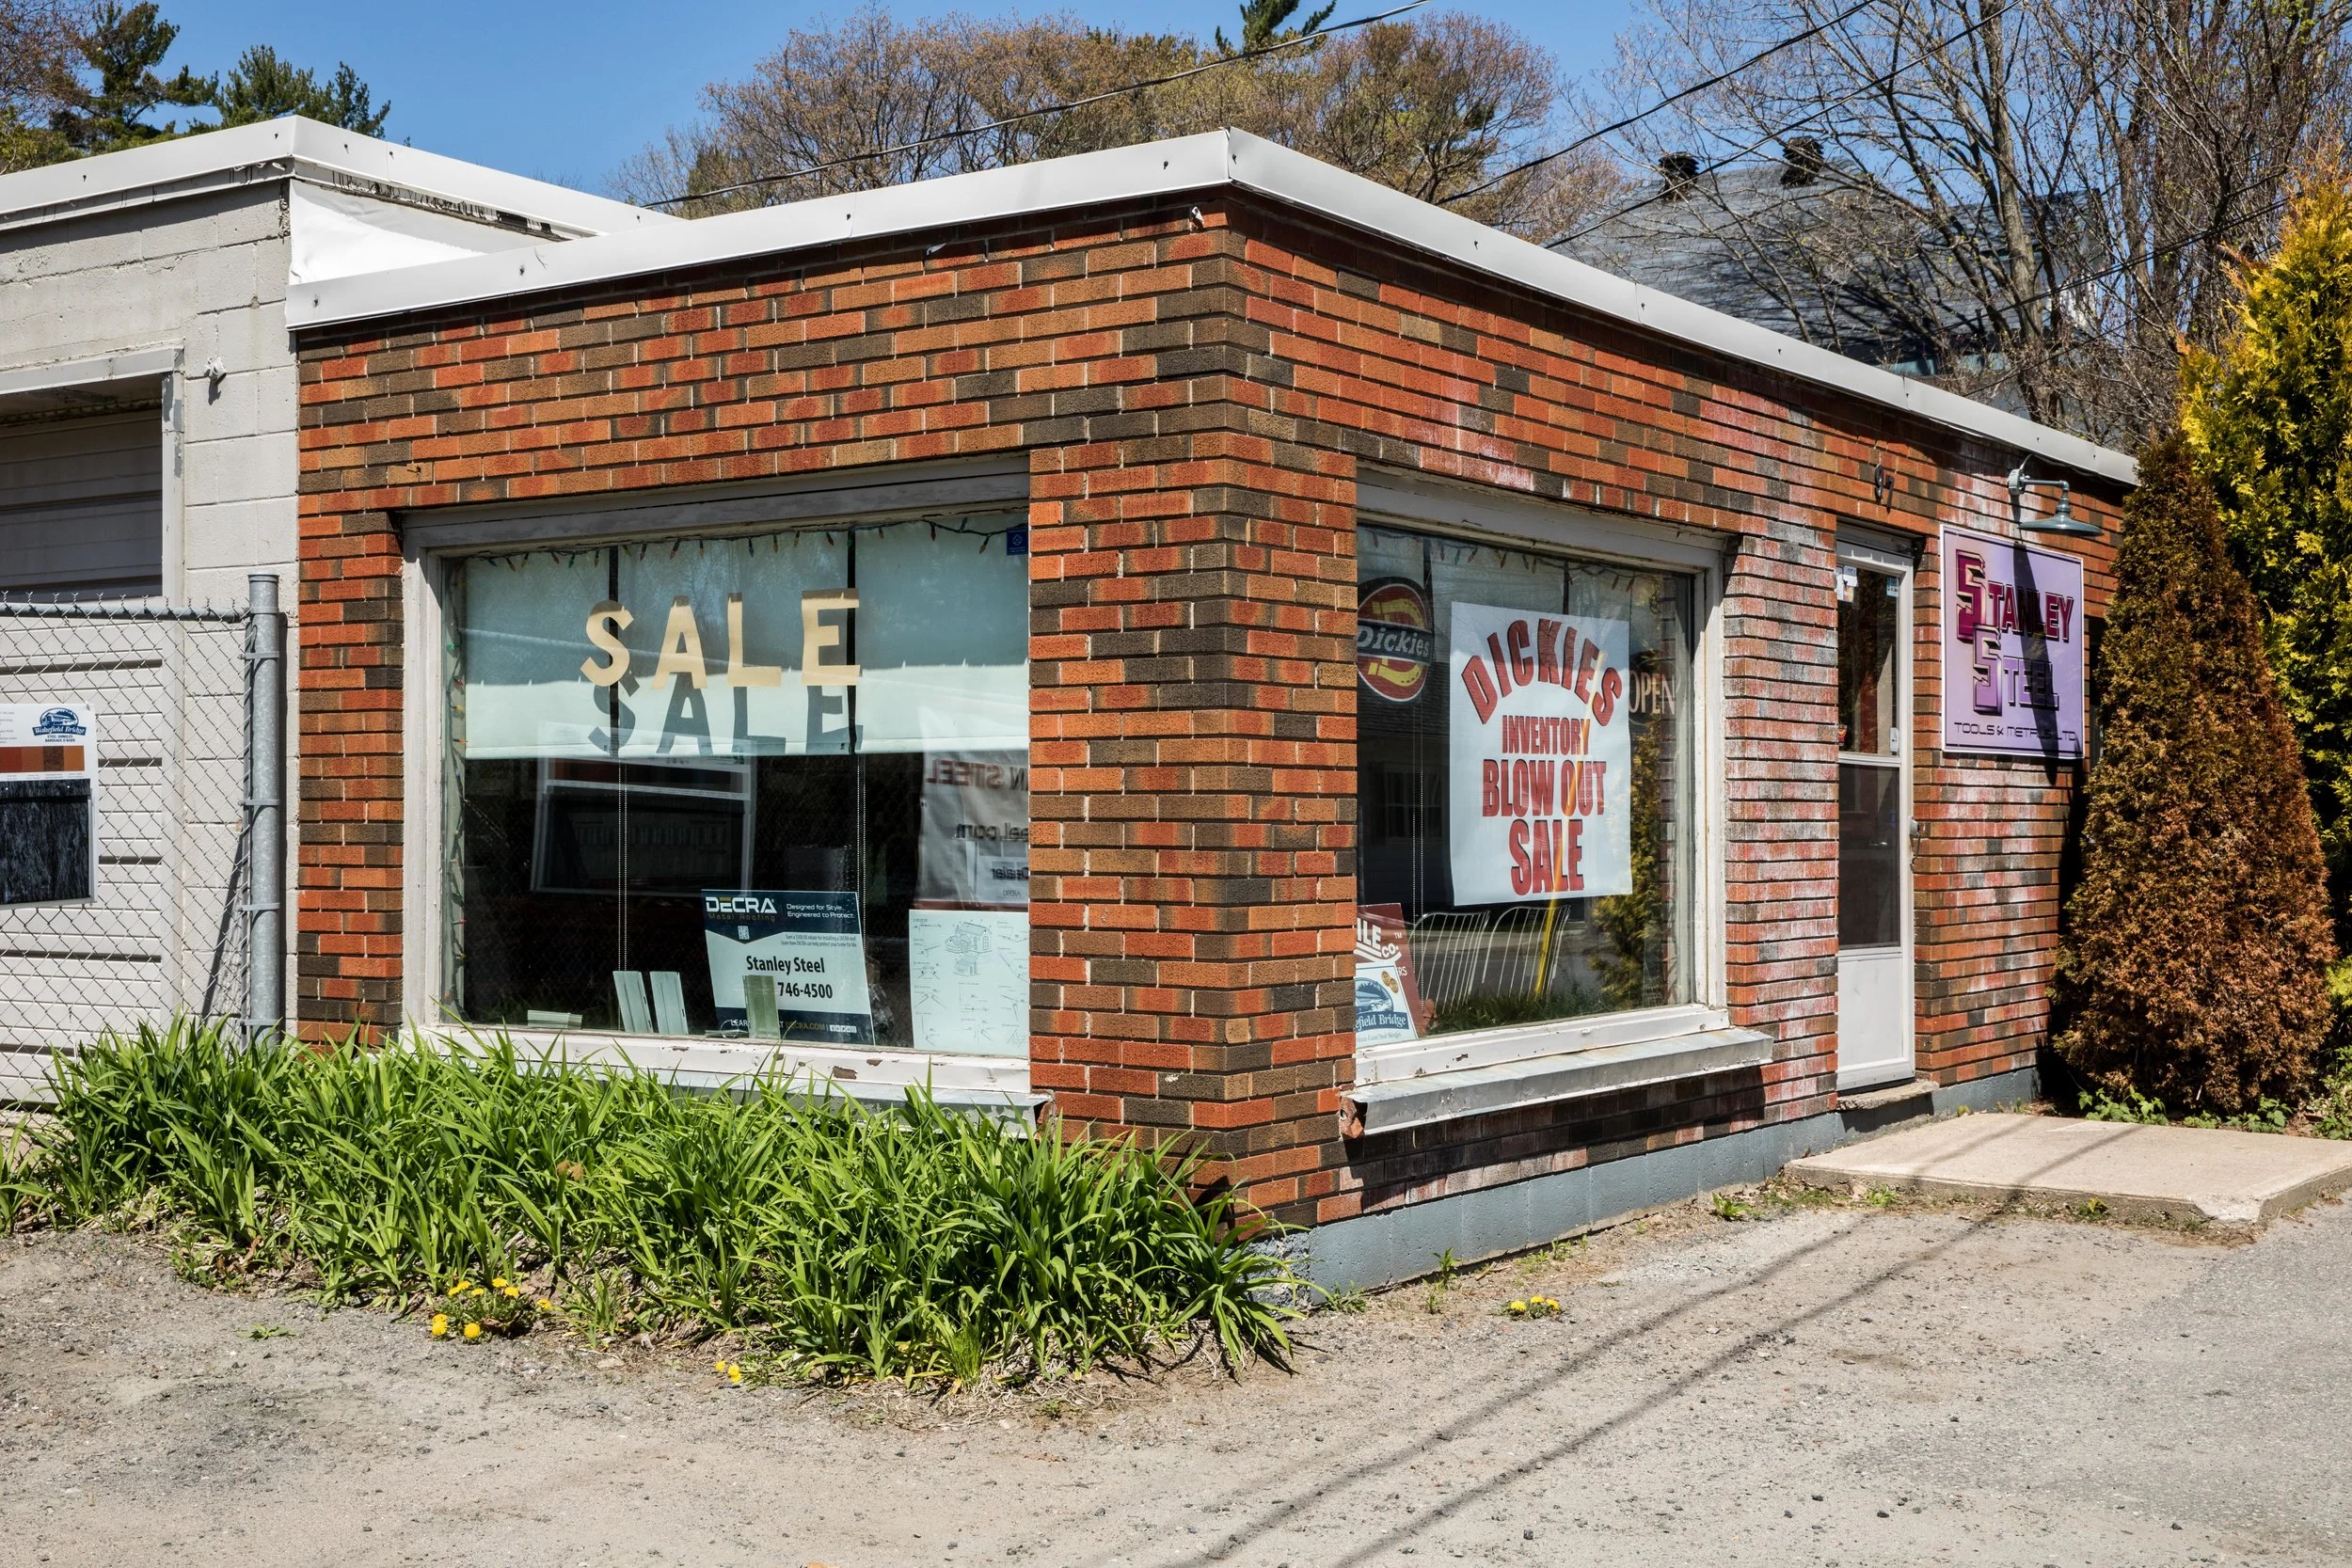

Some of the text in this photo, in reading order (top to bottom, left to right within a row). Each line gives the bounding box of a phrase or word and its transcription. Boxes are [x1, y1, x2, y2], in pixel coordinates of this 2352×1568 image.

[580, 587, 861, 689] SALE
[1358, 625, 1430, 657] Dickies
[1461, 618, 1622, 727] DICKIES
[1629, 669, 1676, 715] OPEN
[1502, 715, 1590, 754] INVENTORY
[1954, 721, 1994, 736] TOOLS
[1996, 725, 2004, 736] &
[1482, 758, 1606, 817] BLOW OUT
[1509, 818, 1584, 895] SALE
[706, 896, 777, 913] DECRA
[739, 913, 776, 922] Roofing
[1381, 942, 1399, 958] CO.
[746, 956, 825, 975] Stanley Steel
[777, 981, 834, 999] 746-4500
[1378, 1014, 1406, 1028] Bridge
